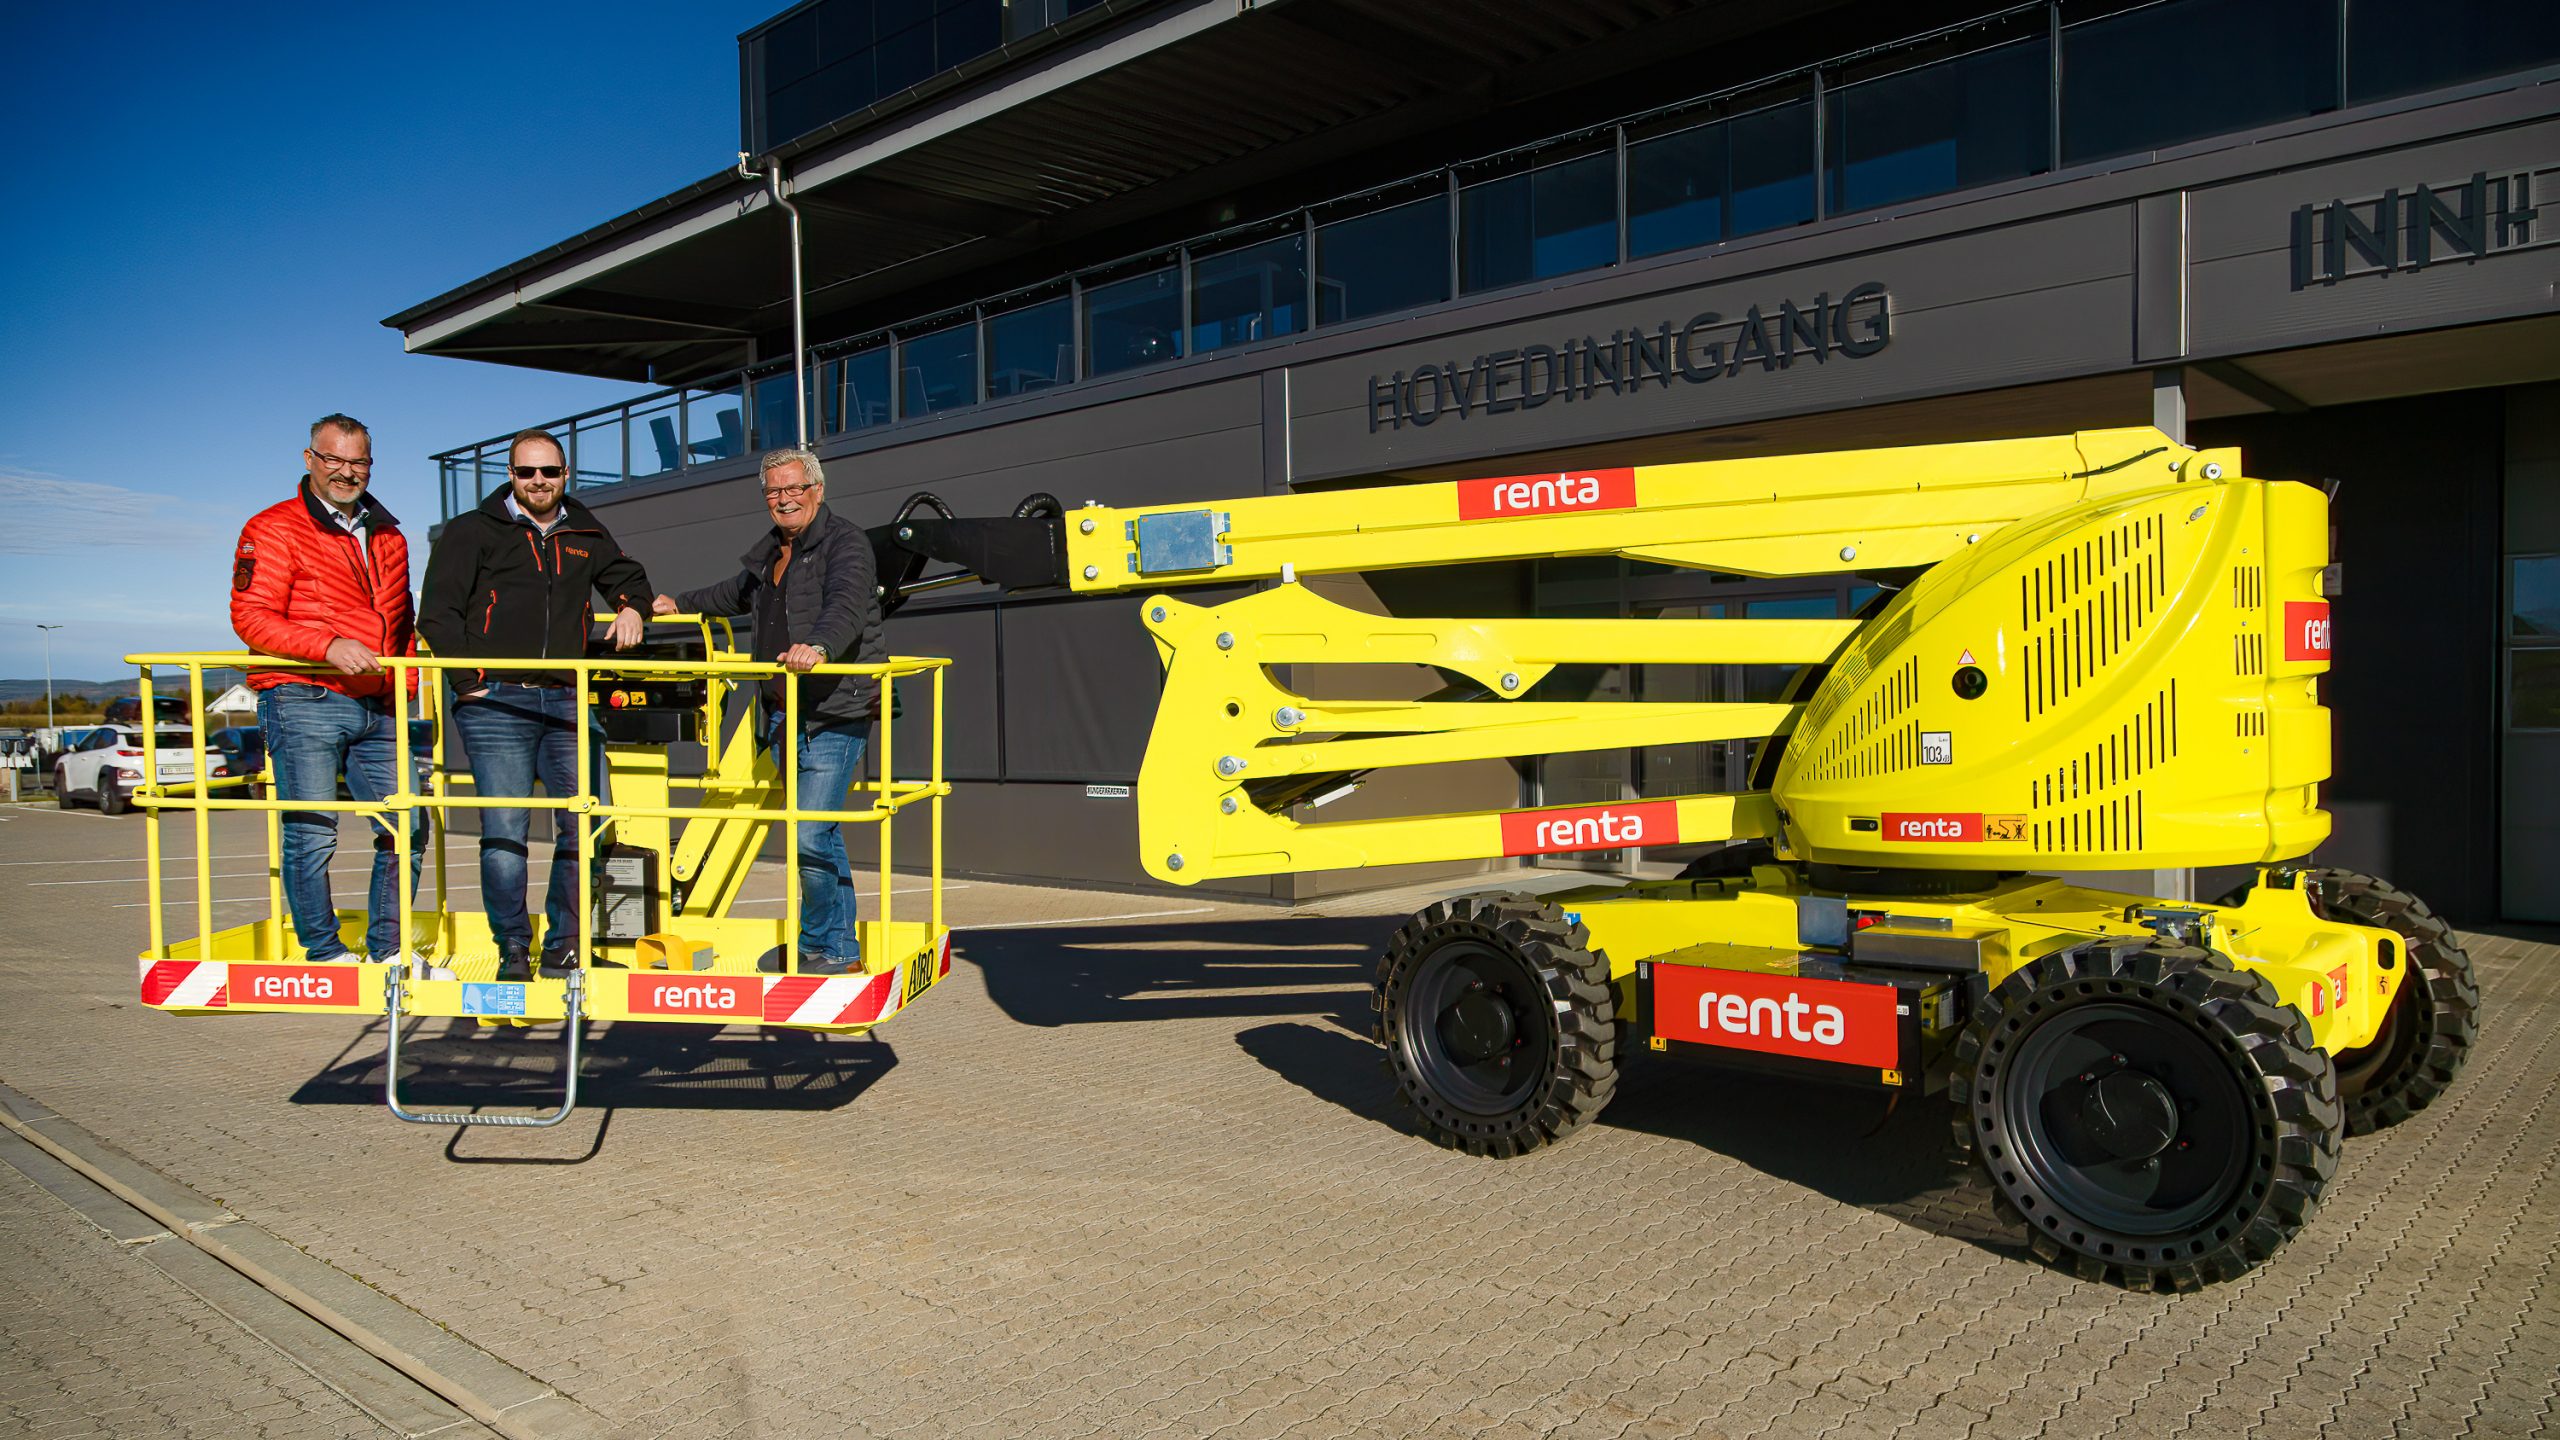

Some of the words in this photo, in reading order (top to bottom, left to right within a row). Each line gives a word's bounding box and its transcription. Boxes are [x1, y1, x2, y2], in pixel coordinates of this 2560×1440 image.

[1369, 281, 1891, 434] HOVEDINNGANG
[1493, 472, 1600, 511] renta
[1923, 745, 1943, 763] 103
[1535, 810, 1644, 848] renta
[1899, 817, 1963, 837] renta
[253, 972, 333, 999] renta
[907, 947, 934, 997] AIRO
[653, 982, 736, 1009] renta
[1698, 991, 1845, 1046] renta
